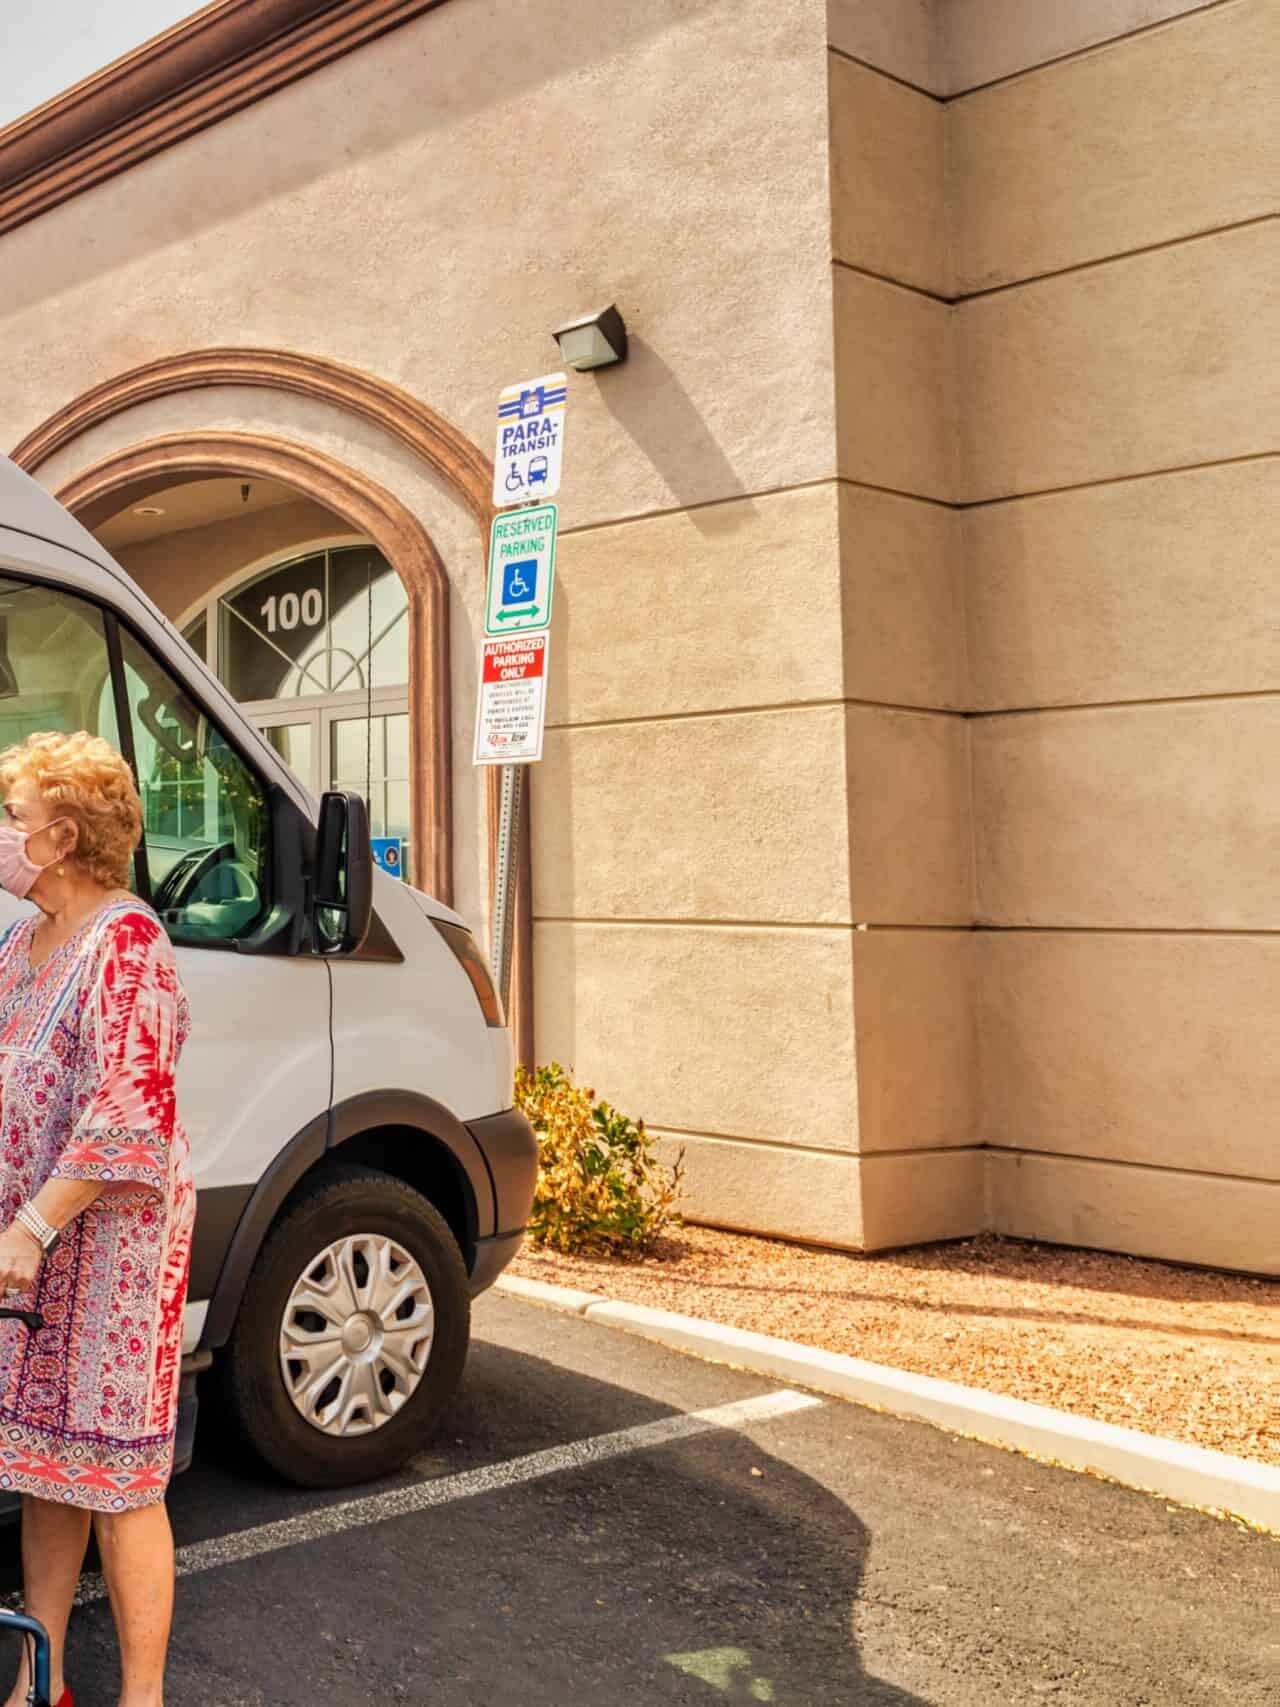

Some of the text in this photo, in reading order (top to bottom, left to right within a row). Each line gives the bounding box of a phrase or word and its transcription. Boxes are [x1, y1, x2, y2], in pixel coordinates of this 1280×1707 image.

[502, 417, 558, 445] PARA-
[502, 434, 557, 458] TRANSIT
[496, 514, 552, 538] RESERVED
[500, 537, 545, 558] PARKING
[260, 588, 322, 633] 100
[485, 639, 544, 656] AUTHORIZED
[493, 652, 535, 668] PARKING
[500, 666, 527, 681] ONLY
